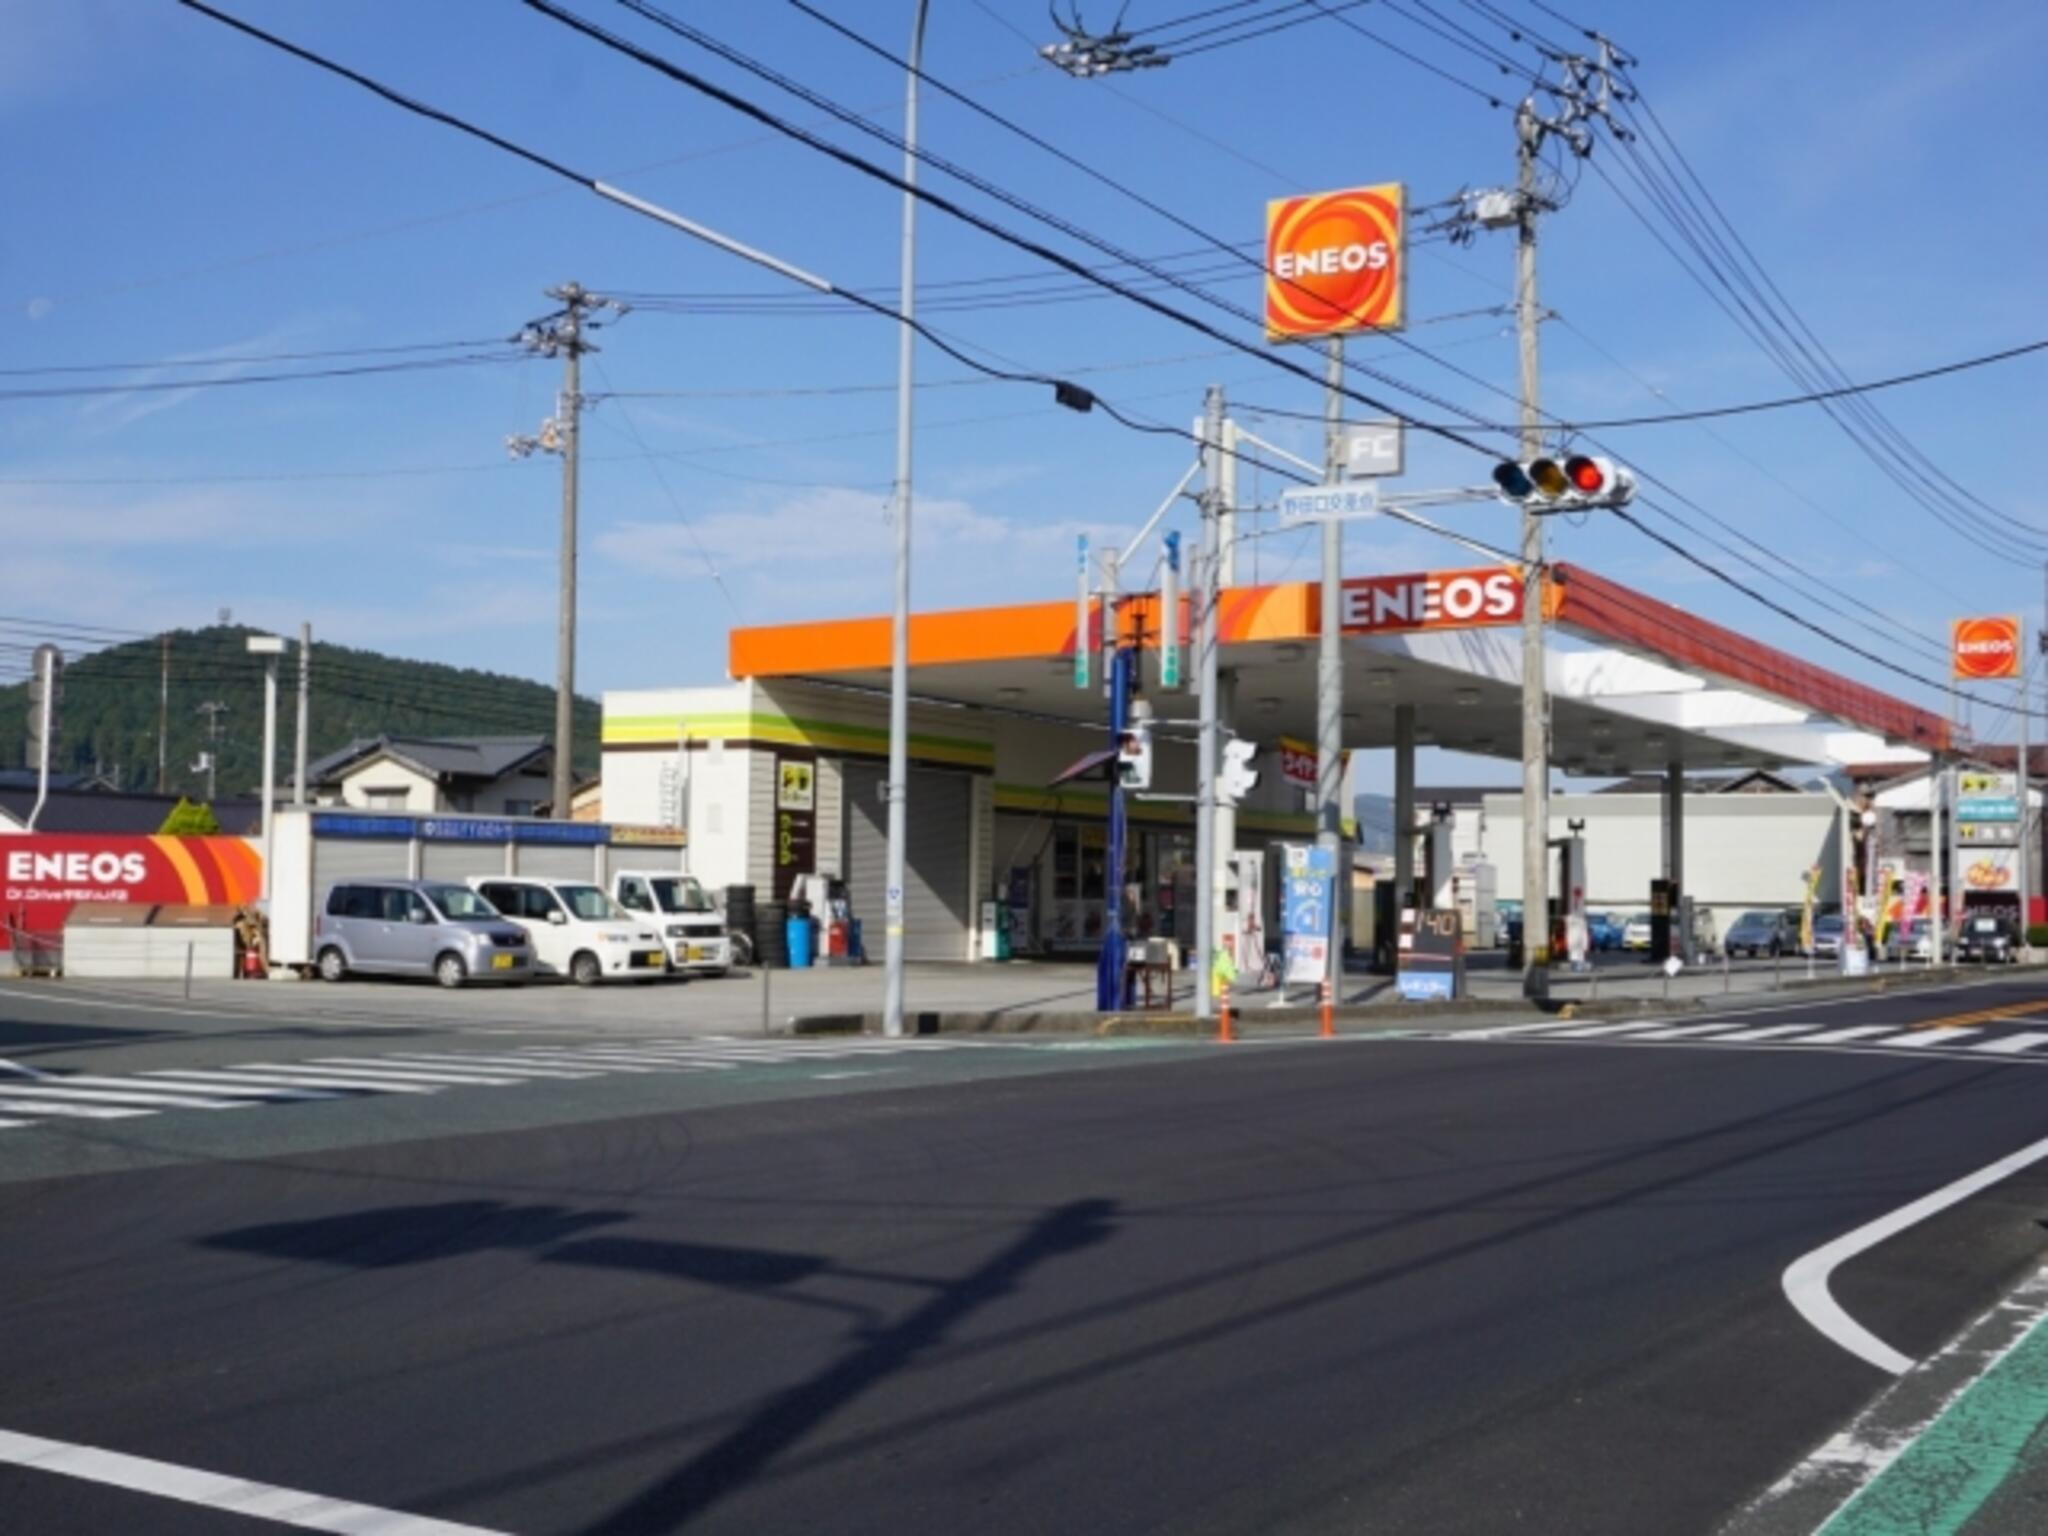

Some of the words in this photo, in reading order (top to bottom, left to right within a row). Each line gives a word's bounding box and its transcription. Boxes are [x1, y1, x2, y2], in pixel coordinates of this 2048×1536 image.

[1275, 241, 1389, 279] ENEOS
[1350, 433, 1395, 460] FC
[1342, 575, 1516, 625] ENEOS
[1957, 638, 2014, 655] ENEOS
[8, 851, 147, 884] ENEOS
[1416, 912, 1456, 936] 140
